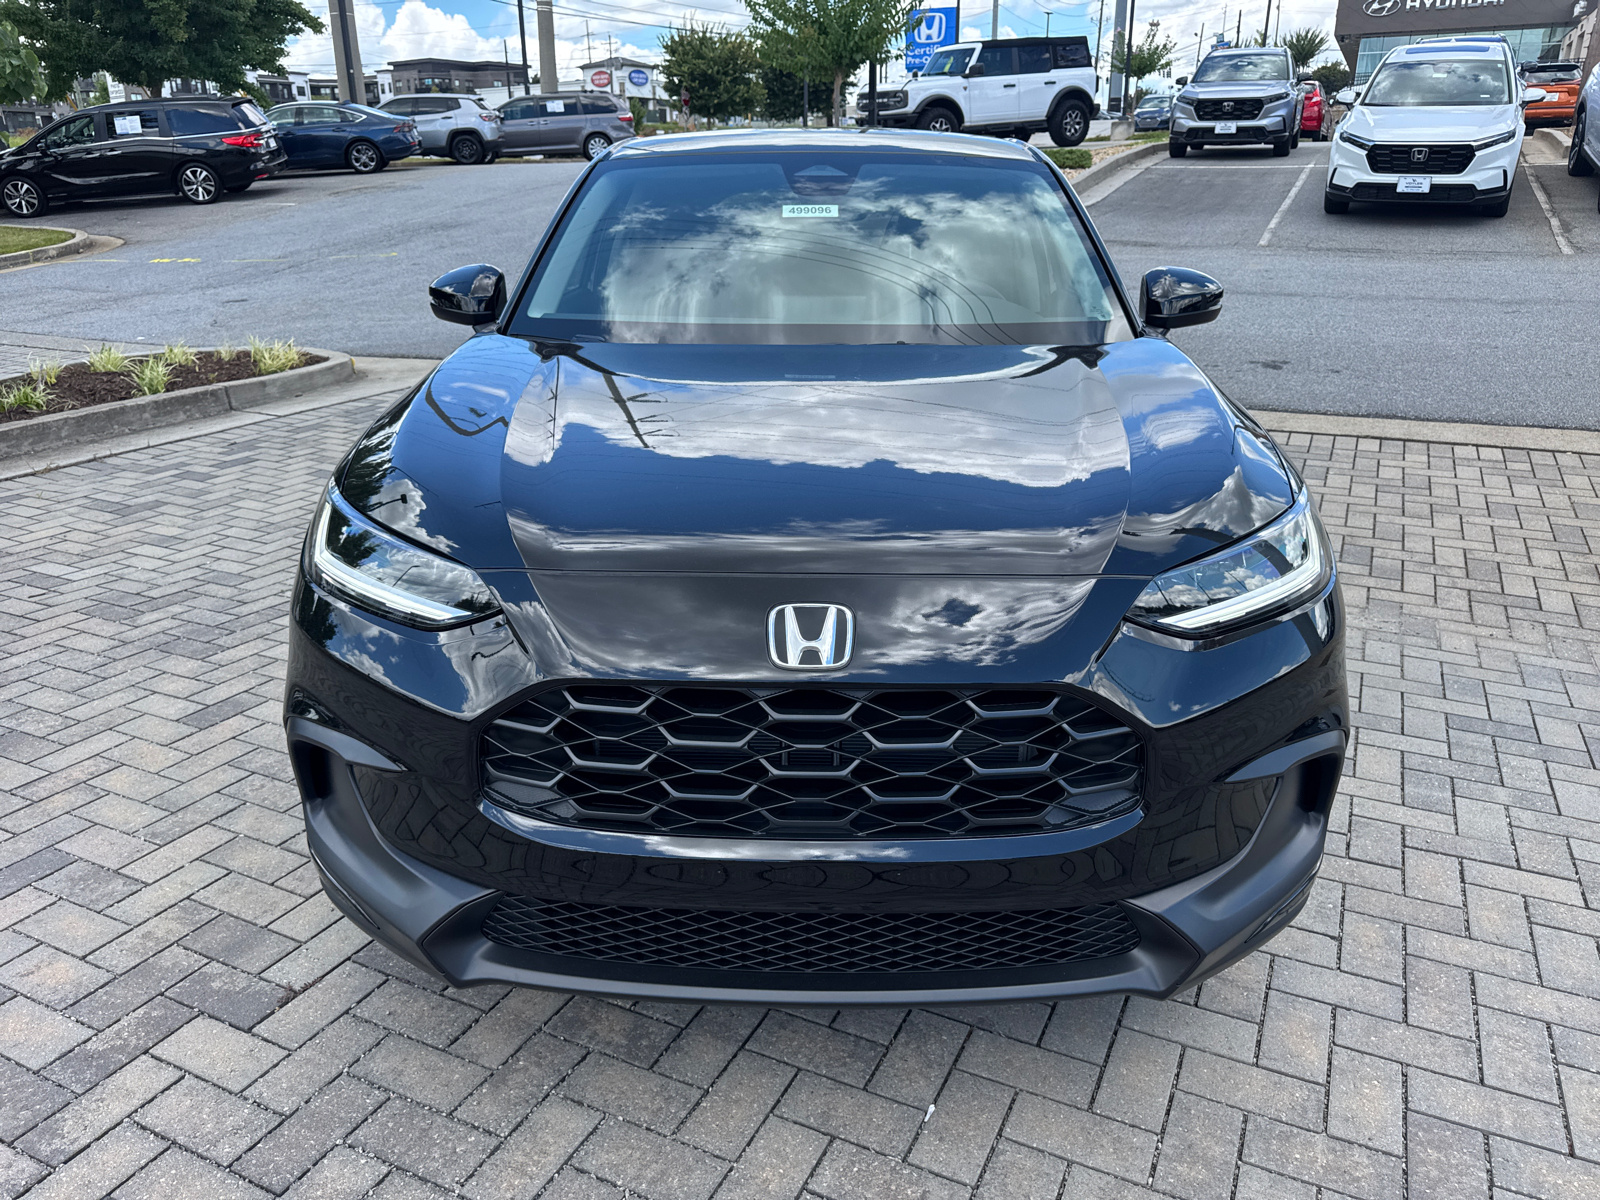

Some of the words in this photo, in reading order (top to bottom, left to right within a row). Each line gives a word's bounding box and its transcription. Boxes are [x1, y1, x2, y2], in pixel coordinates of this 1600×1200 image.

[1405, 0, 1505, 12] HYUND
[907, 45, 941, 55] Certif
[907, 56, 931, 64] Pre-O
